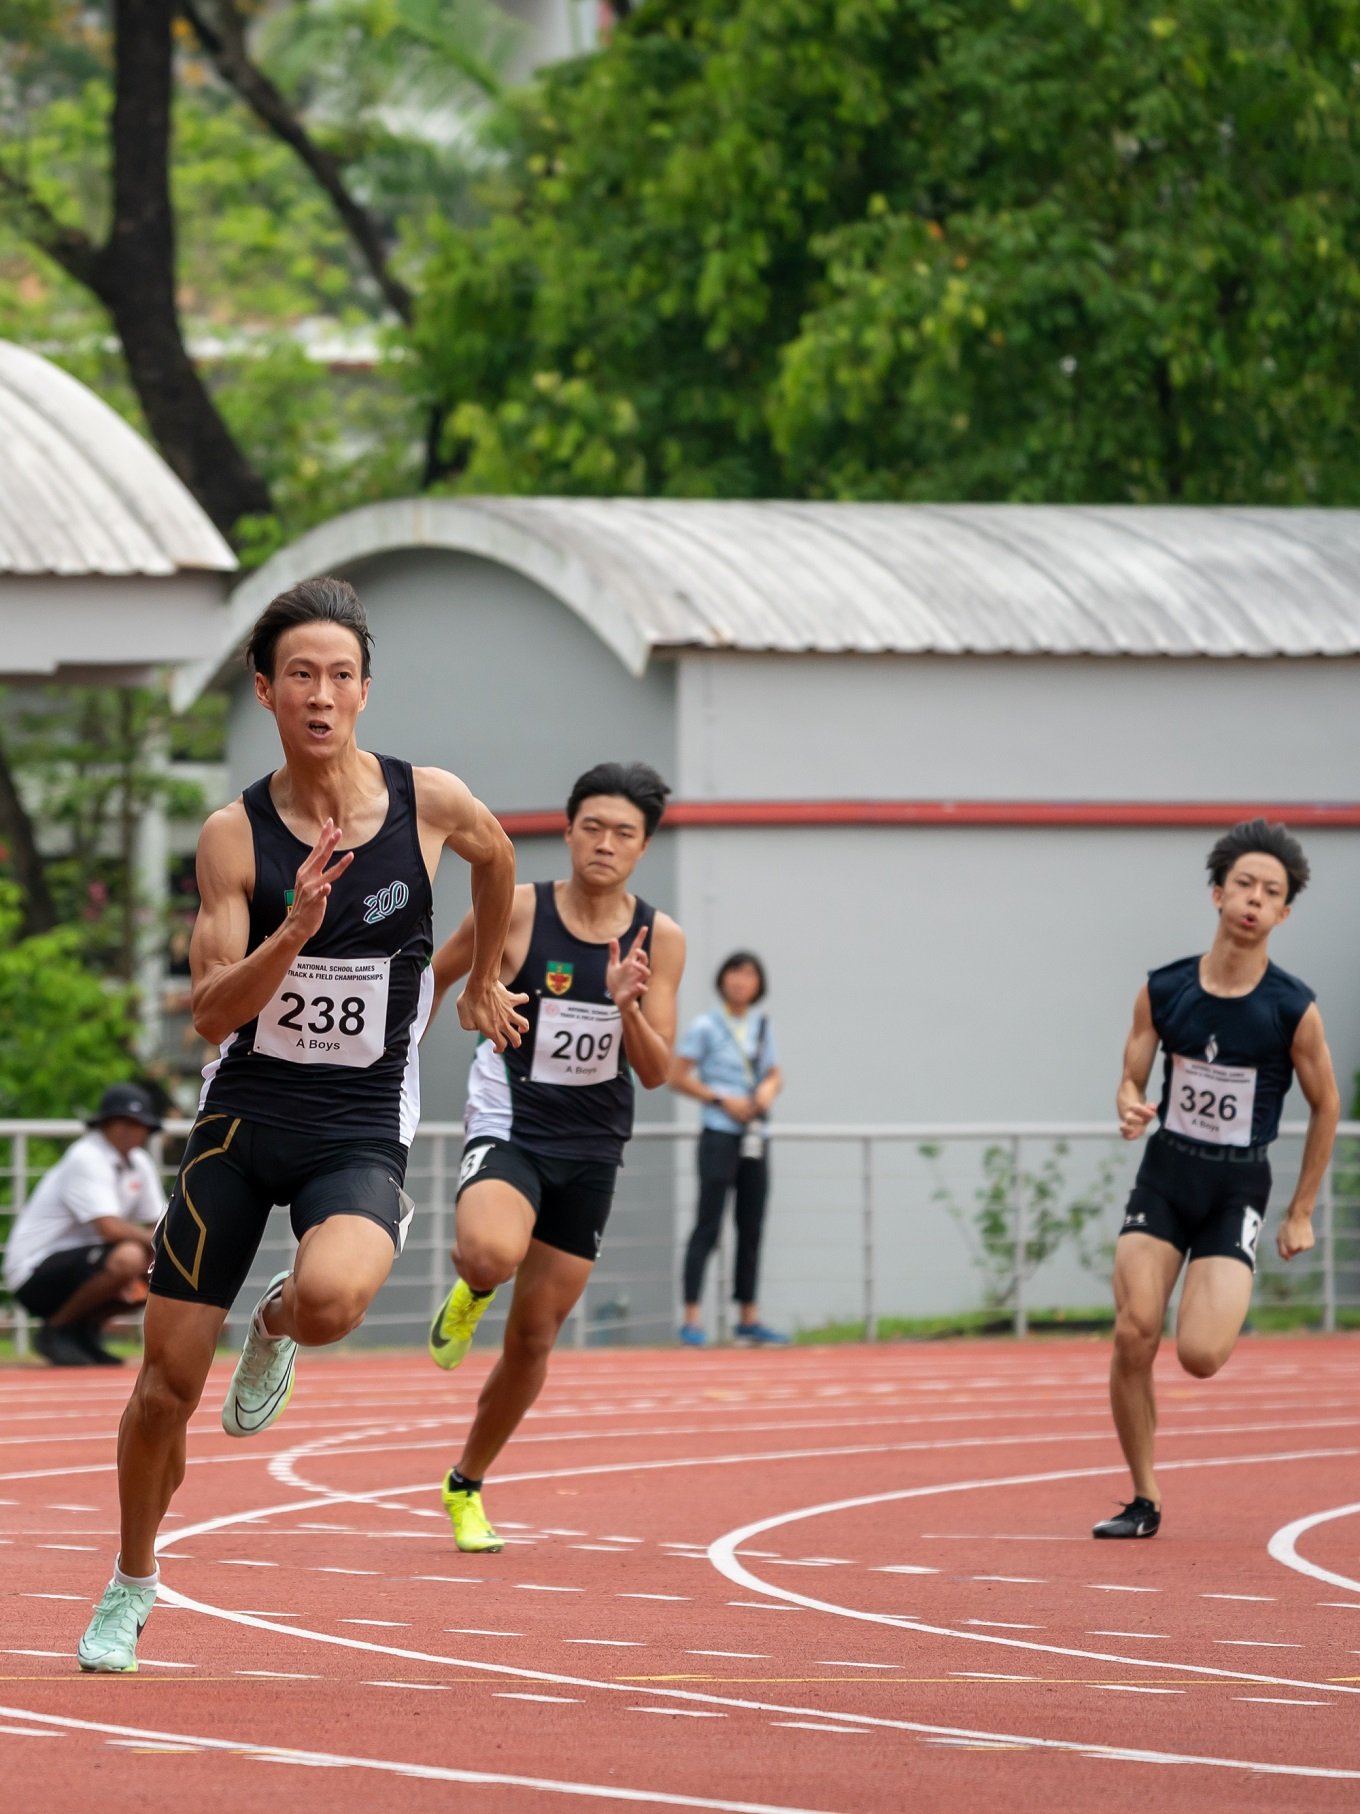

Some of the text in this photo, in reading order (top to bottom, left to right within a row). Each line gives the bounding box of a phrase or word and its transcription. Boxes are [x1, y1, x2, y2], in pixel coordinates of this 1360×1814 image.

[363, 880, 409, 925] 200
[287, 969, 308, 978] TRACK
[334, 973, 383, 981] CHAMPIONSHIPS
[296, 963, 328, 971] NATIONAL
[329, 965, 354, 973] SCHOOL
[277, 991, 366, 1036] 238
[296, 1038, 341, 1052] A Boys
[550, 1030, 613, 1062] 209
[566, 1065, 597, 1075] A Boys
[1180, 1085, 1237, 1121] 326
